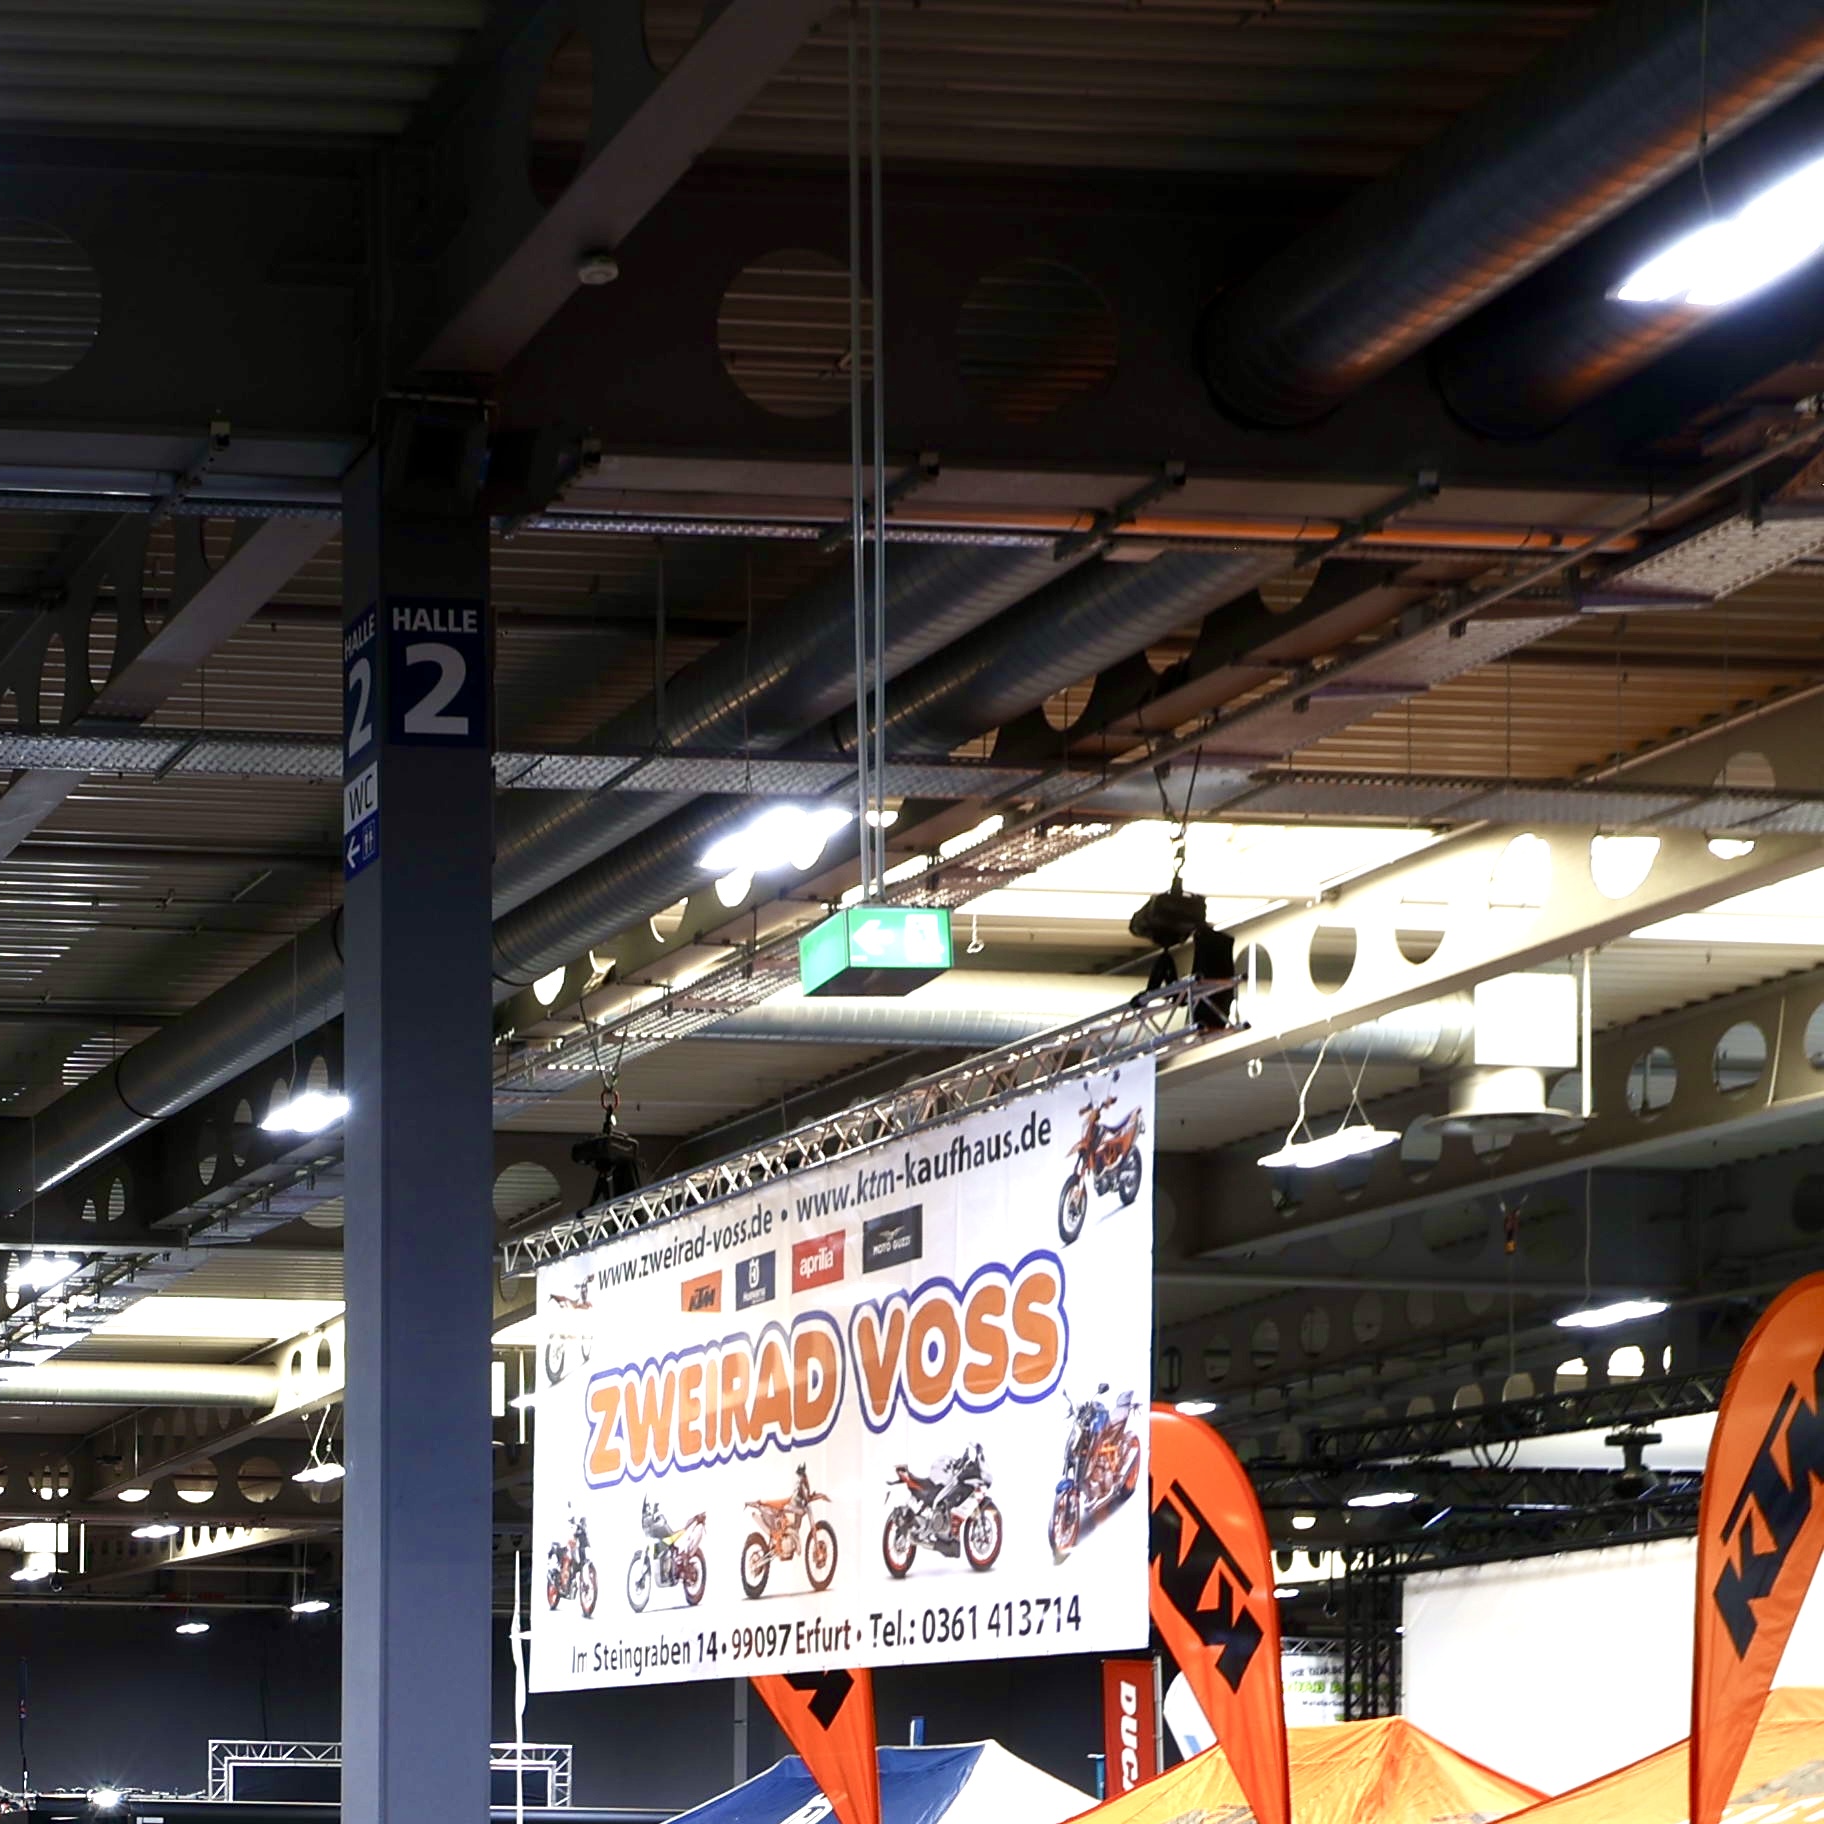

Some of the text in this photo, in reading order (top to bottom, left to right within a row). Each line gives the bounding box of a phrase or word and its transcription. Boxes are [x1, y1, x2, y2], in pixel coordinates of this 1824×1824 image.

[345, 613, 375, 659] HALLE
[393, 607, 477, 634] HALLE
[348, 657, 372, 757] 2
[405, 642, 468, 735] 2
[348, 774, 373, 819] WC
[598, 1112, 1052, 1291] www.zweirad-voss.de www.ktm-kaufhaus.de
[800, 1247, 834, 1279] aprilia
[588, 1260, 1063, 1482] ZWEIRAD VOSS
[571, 1594, 1083, 1678] Im Steingraben 14 99097 Erfurt Tel.: 0361 413714
